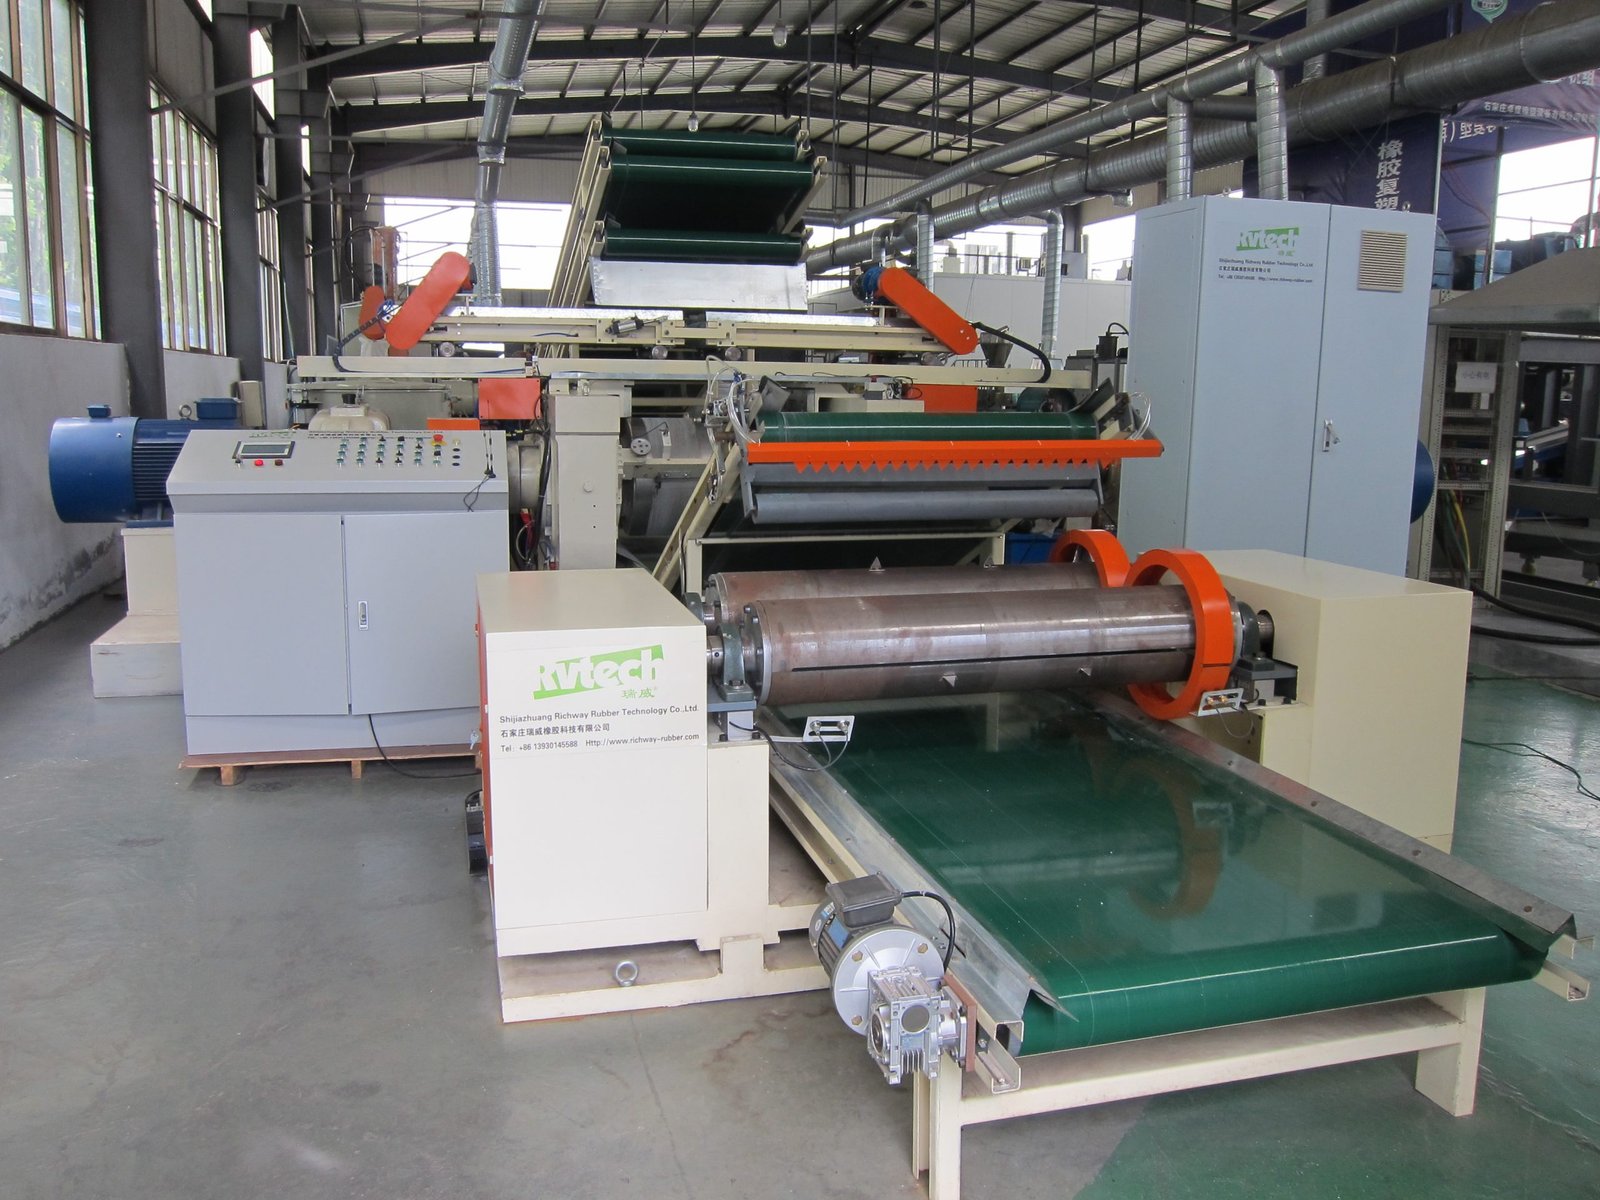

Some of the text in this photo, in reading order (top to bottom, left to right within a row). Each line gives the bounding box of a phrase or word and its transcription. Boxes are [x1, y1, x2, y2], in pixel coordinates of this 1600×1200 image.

[499, 713, 552, 725] Shijiazhuang
[554, 711, 589, 720] Richway
[591, 709, 620, 718] Rubber
[622, 706, 667, 716] Technology
[500, 722, 611, 738] 石家庄瑞威橡胶科技有限公司
[519, 742, 532, 752] +86
[533, 740, 578, 751] 13930145588
